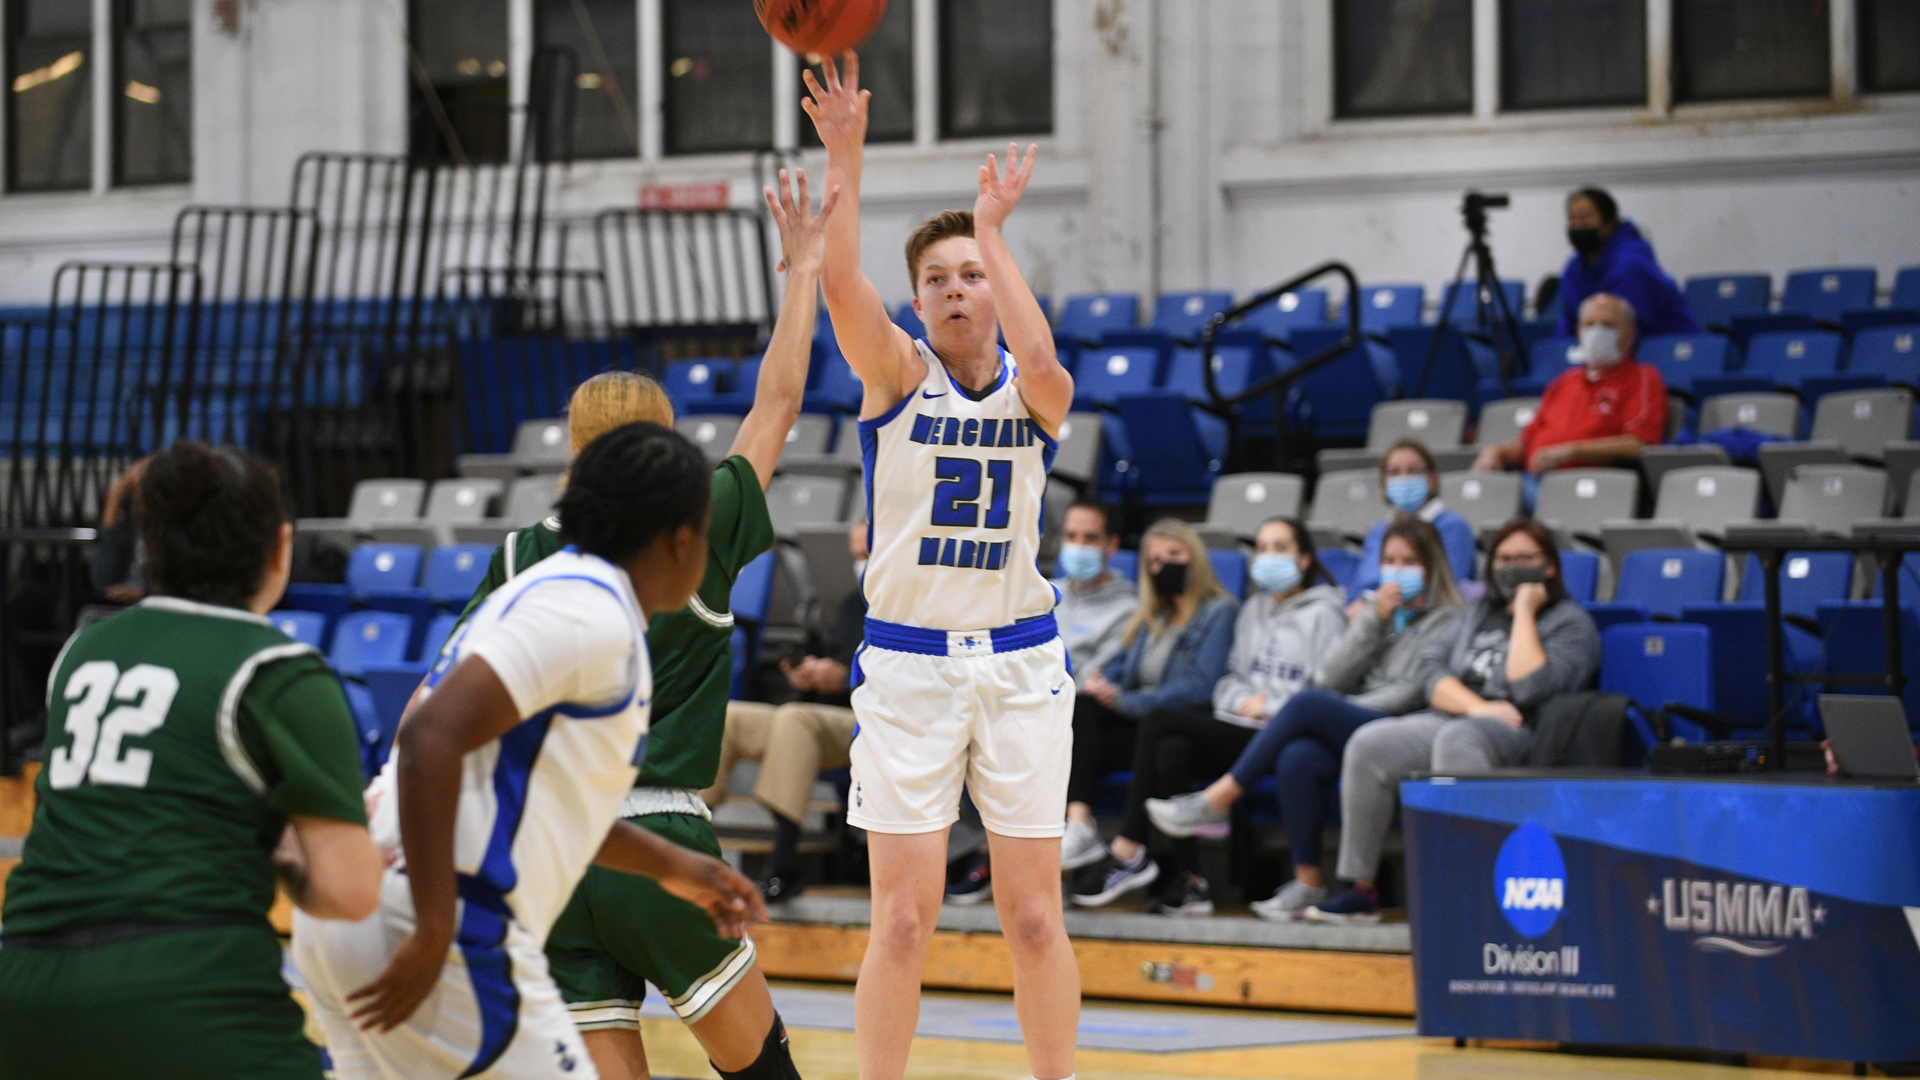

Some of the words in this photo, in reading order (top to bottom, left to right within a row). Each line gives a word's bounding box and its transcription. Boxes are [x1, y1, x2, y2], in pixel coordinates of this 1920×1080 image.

[931, 456, 1013, 529] 21
[49, 660, 180, 790] 32
[1503, 877, 1564, 911] NCAA
[1663, 878, 1813, 939] USMMA
[1483, 943, 1560, 977] Division
[1561, 945, 1580, 978] III
